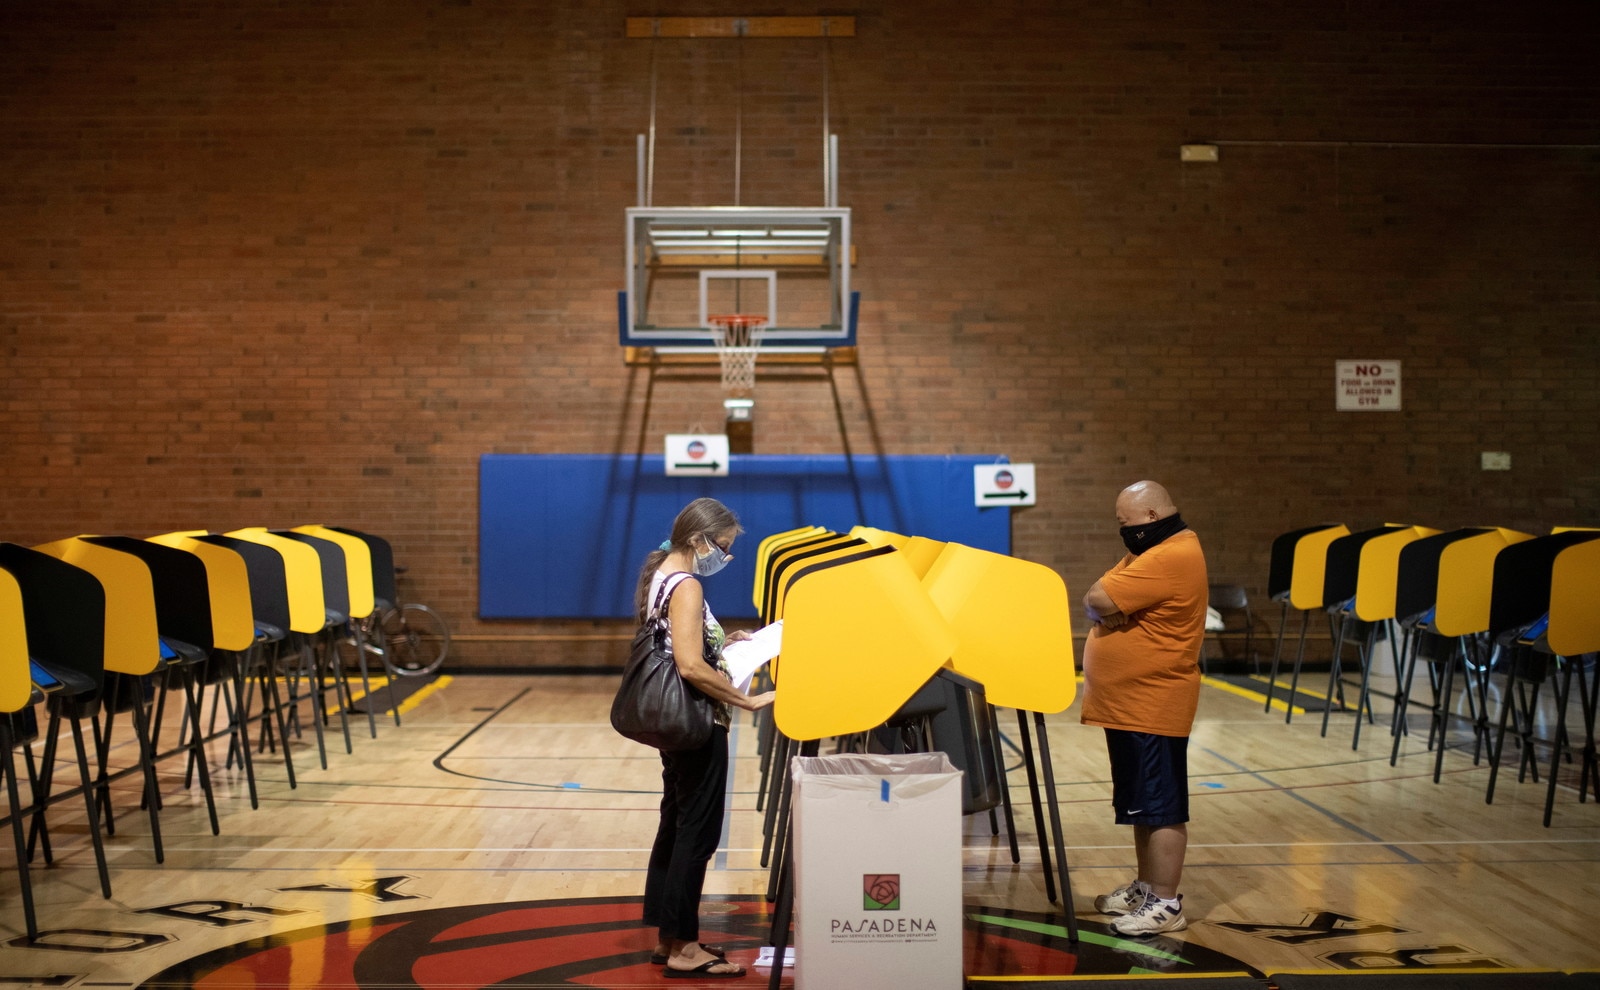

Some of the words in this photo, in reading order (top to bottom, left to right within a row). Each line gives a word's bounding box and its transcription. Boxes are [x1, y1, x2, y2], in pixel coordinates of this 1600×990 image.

[1355, 364, 1382, 377] NO
[1152, 912, 1167, 925] N
[831, 918, 937, 933] PASADENA
